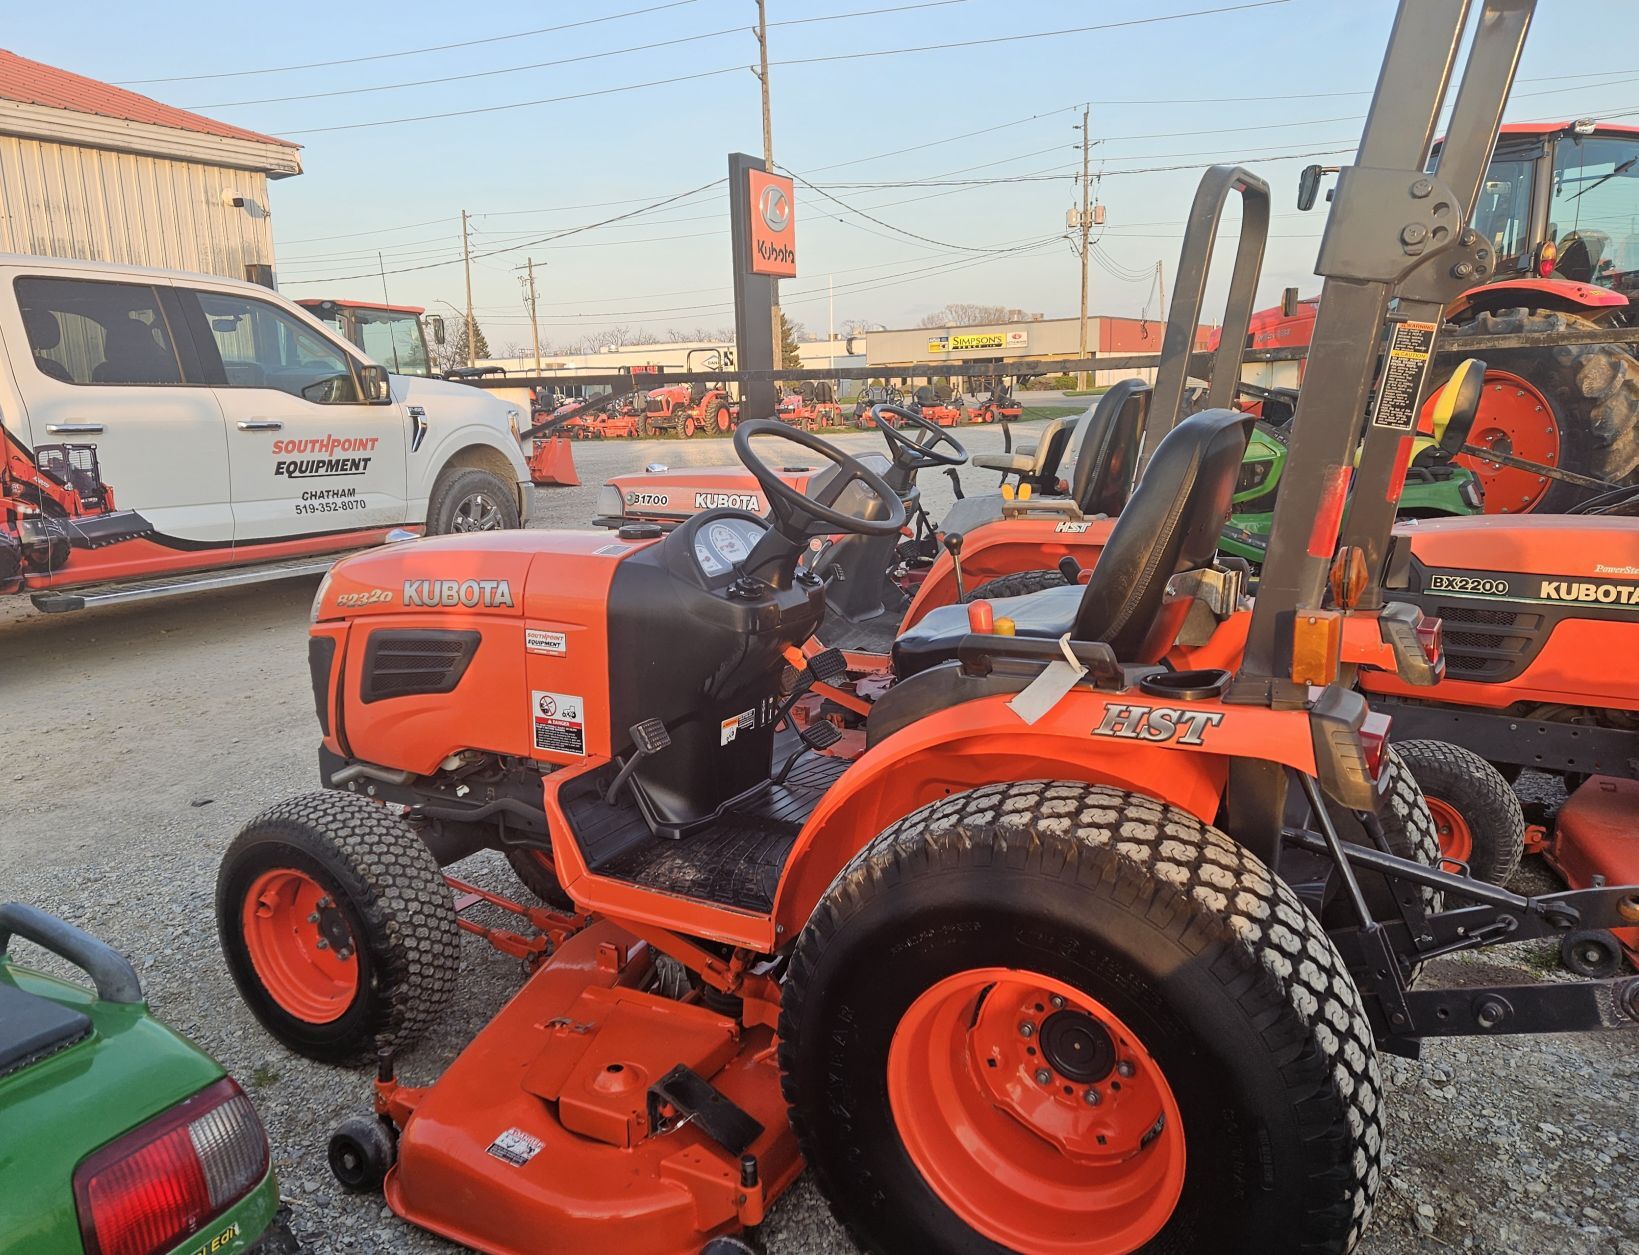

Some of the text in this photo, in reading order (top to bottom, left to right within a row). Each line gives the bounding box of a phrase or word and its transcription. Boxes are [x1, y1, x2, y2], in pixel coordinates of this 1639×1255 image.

[757, 239, 795, 264] Kubota
[952, 335, 1002, 346] SIMPSON'S
[272, 434, 378, 457] SOUTHPOINT
[274, 457, 372, 478] EQUIPMENT
[301, 488, 356, 501] CHATHAM
[694, 492, 760, 511] KUBOTA
[295, 500, 366, 515] 519-352-8070
[1054, 521, 1093, 533] HST
[402, 578, 514, 608] KUBOTA
[1431, 575, 1509, 594] BX2200
[527, 632, 564, 641] SOUTHPOINT
[527, 639, 561, 648] EQUIPMENT
[1090, 702, 1225, 746] HST
